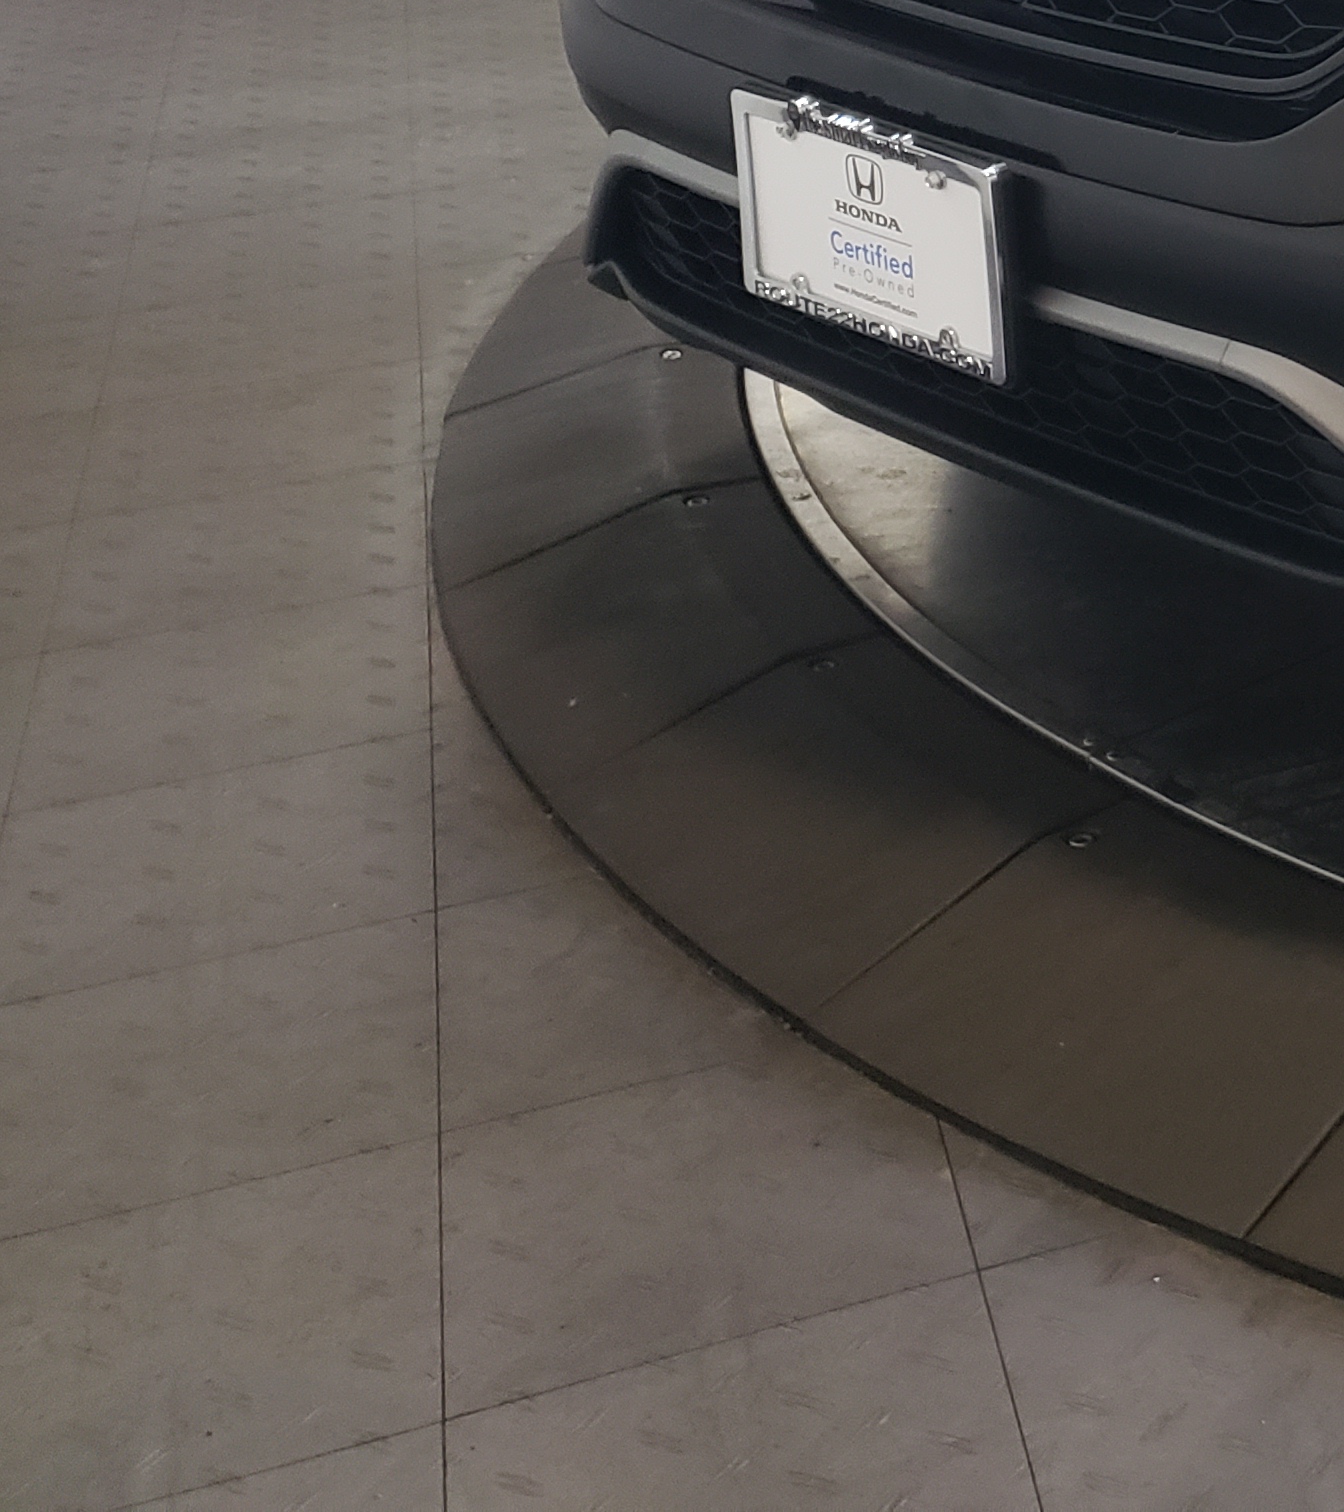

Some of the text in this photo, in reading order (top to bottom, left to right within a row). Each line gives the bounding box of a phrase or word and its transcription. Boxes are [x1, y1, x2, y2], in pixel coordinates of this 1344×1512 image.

[833, 198, 903, 234] HONDA
[829, 229, 914, 280] Certified
[832, 256, 916, 299] Pre-Owned
